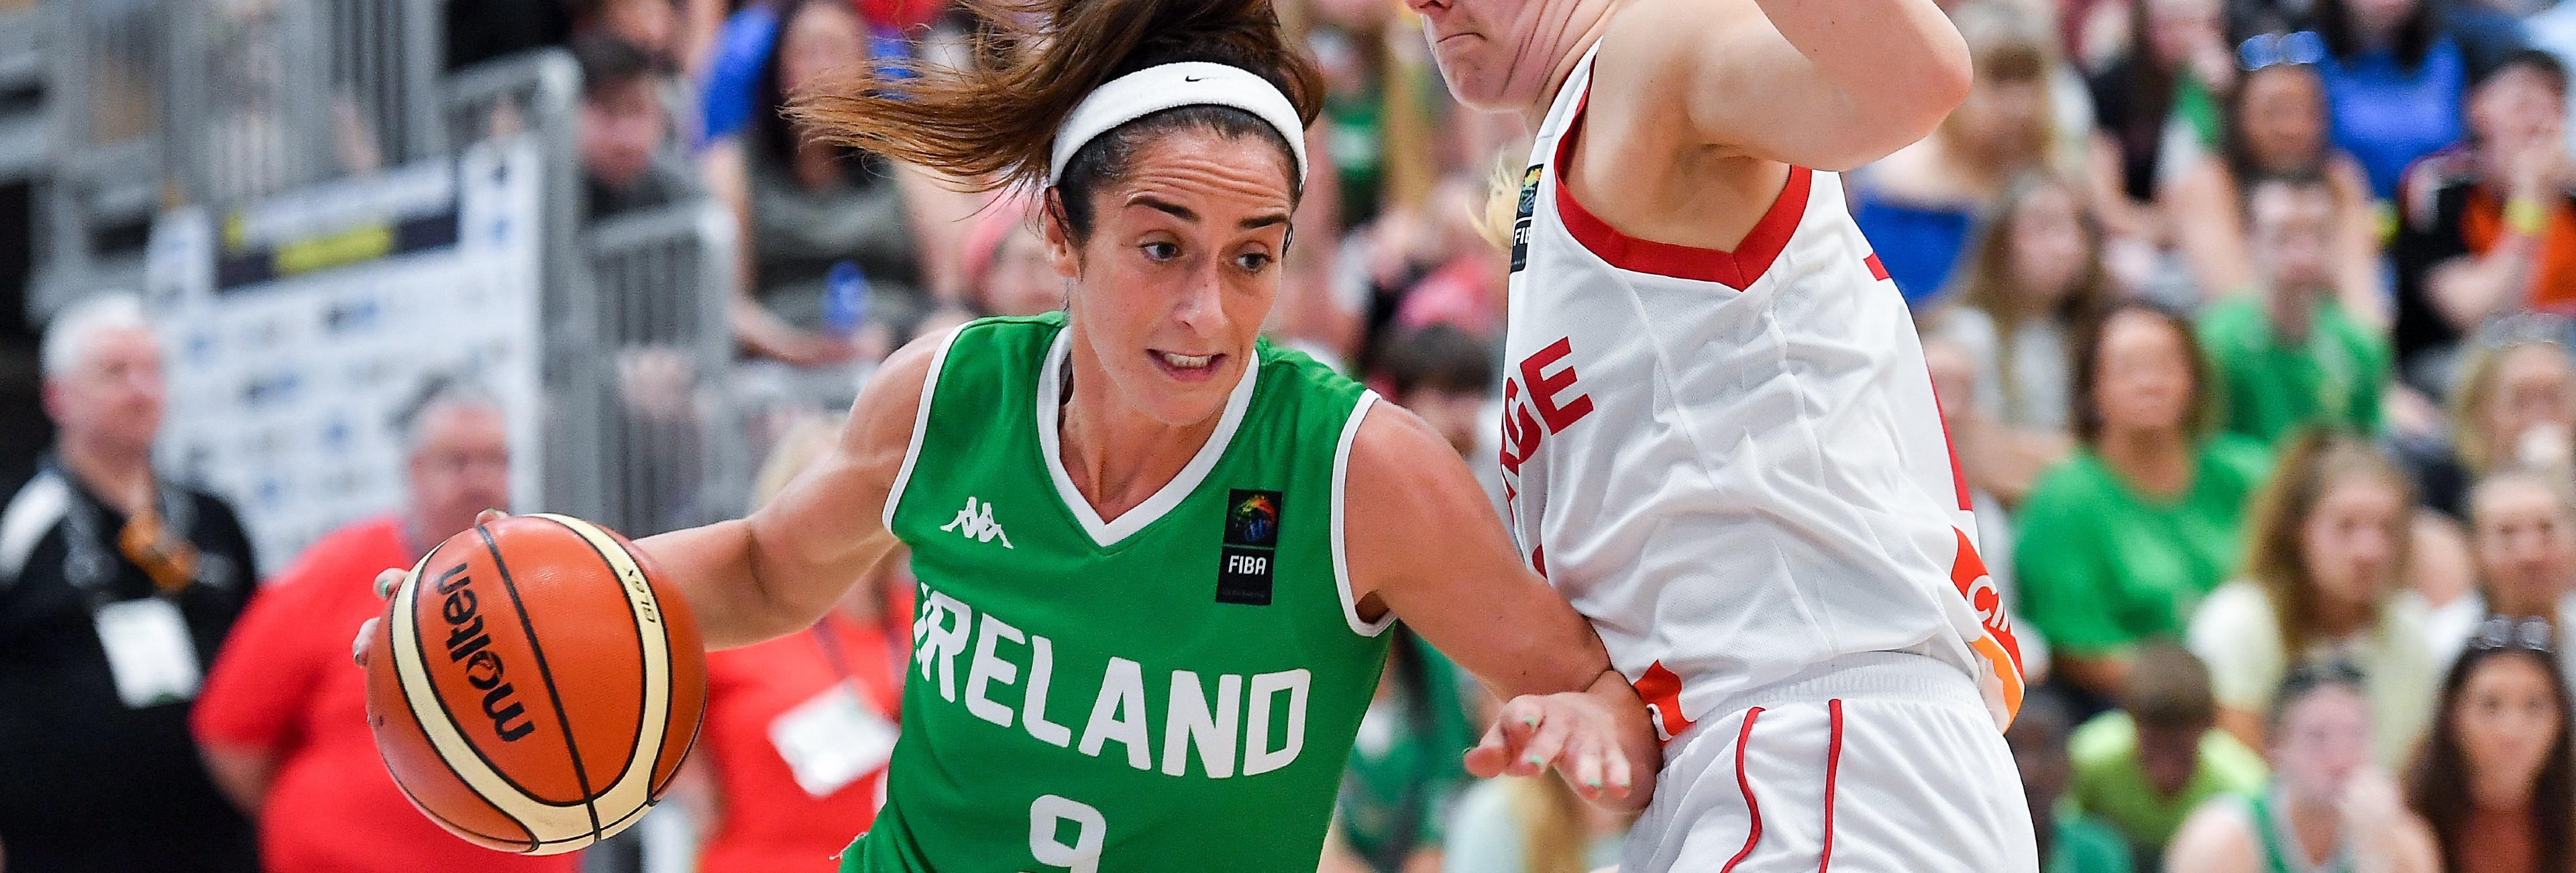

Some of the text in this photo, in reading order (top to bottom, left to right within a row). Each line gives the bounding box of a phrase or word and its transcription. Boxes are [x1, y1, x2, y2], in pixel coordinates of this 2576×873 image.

[1228, 555, 1267, 575] FIBA
[437, 562, 535, 742] molten
[913, 581, 1311, 779] IRELAND
[1018, 794, 1107, 873] 9
